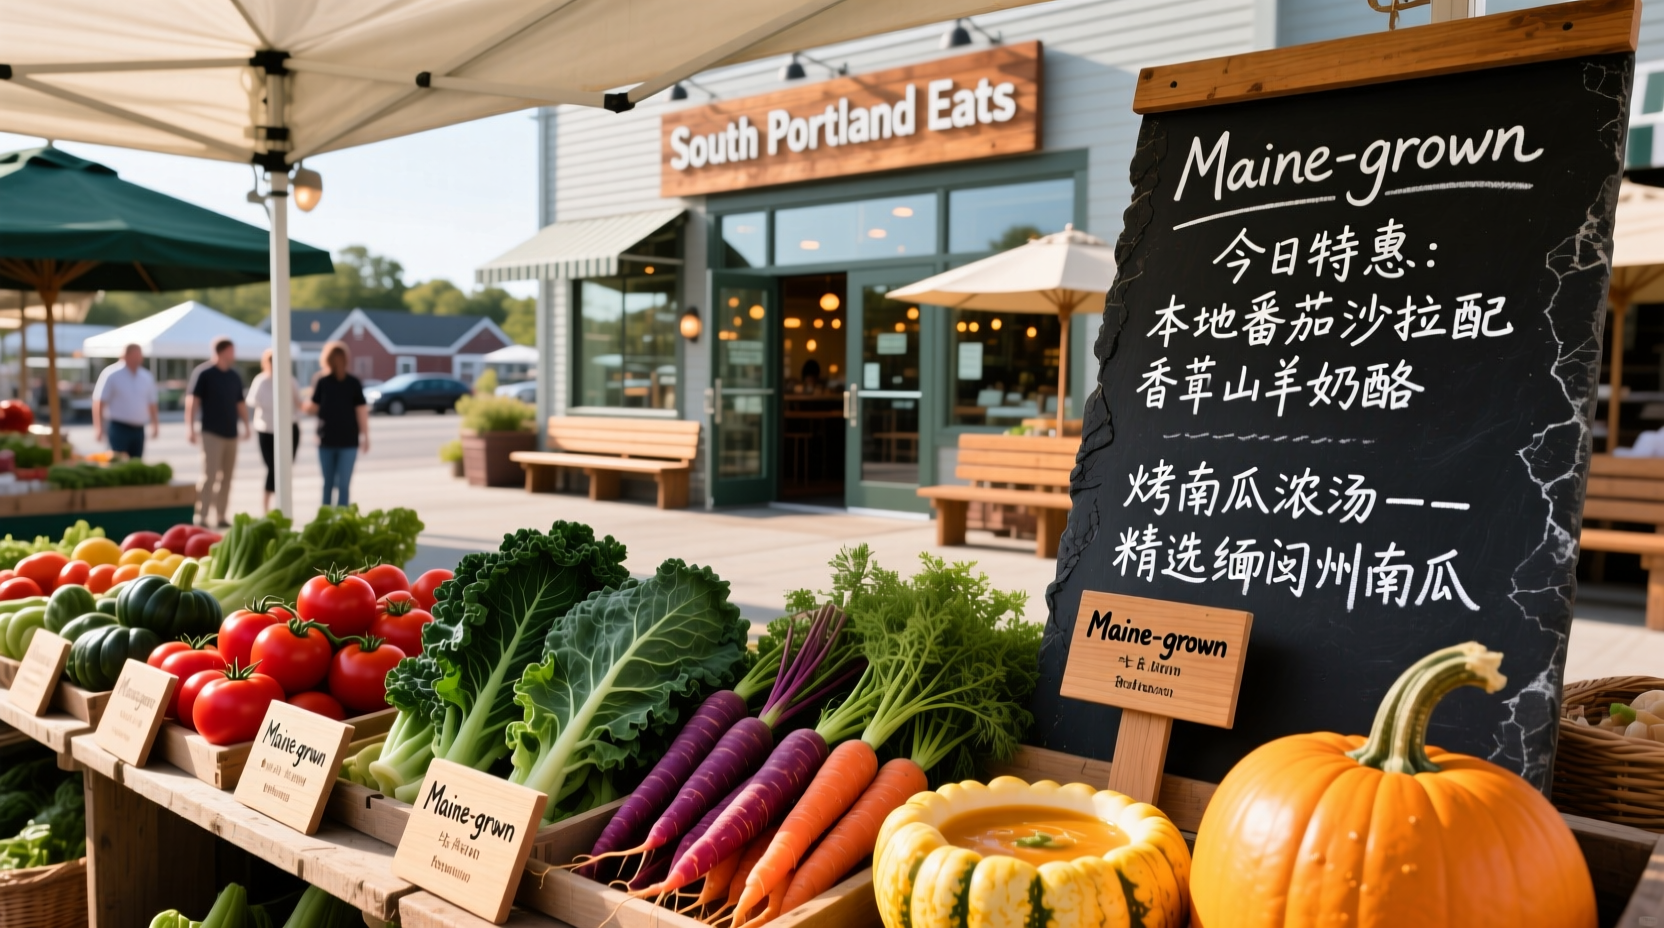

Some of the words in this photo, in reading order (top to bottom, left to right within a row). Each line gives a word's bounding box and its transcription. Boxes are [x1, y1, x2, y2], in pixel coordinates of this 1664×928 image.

[670, 115, 759, 170] South
[767, 83, 916, 155] Portland
[928, 78, 1016, 131] Eats
[1173, 125, 1544, 207] Maine-grown
[1146, 290, 1514, 348] 本地番茄沙拉配
[1086, 609, 1228, 661] Maine-grown
